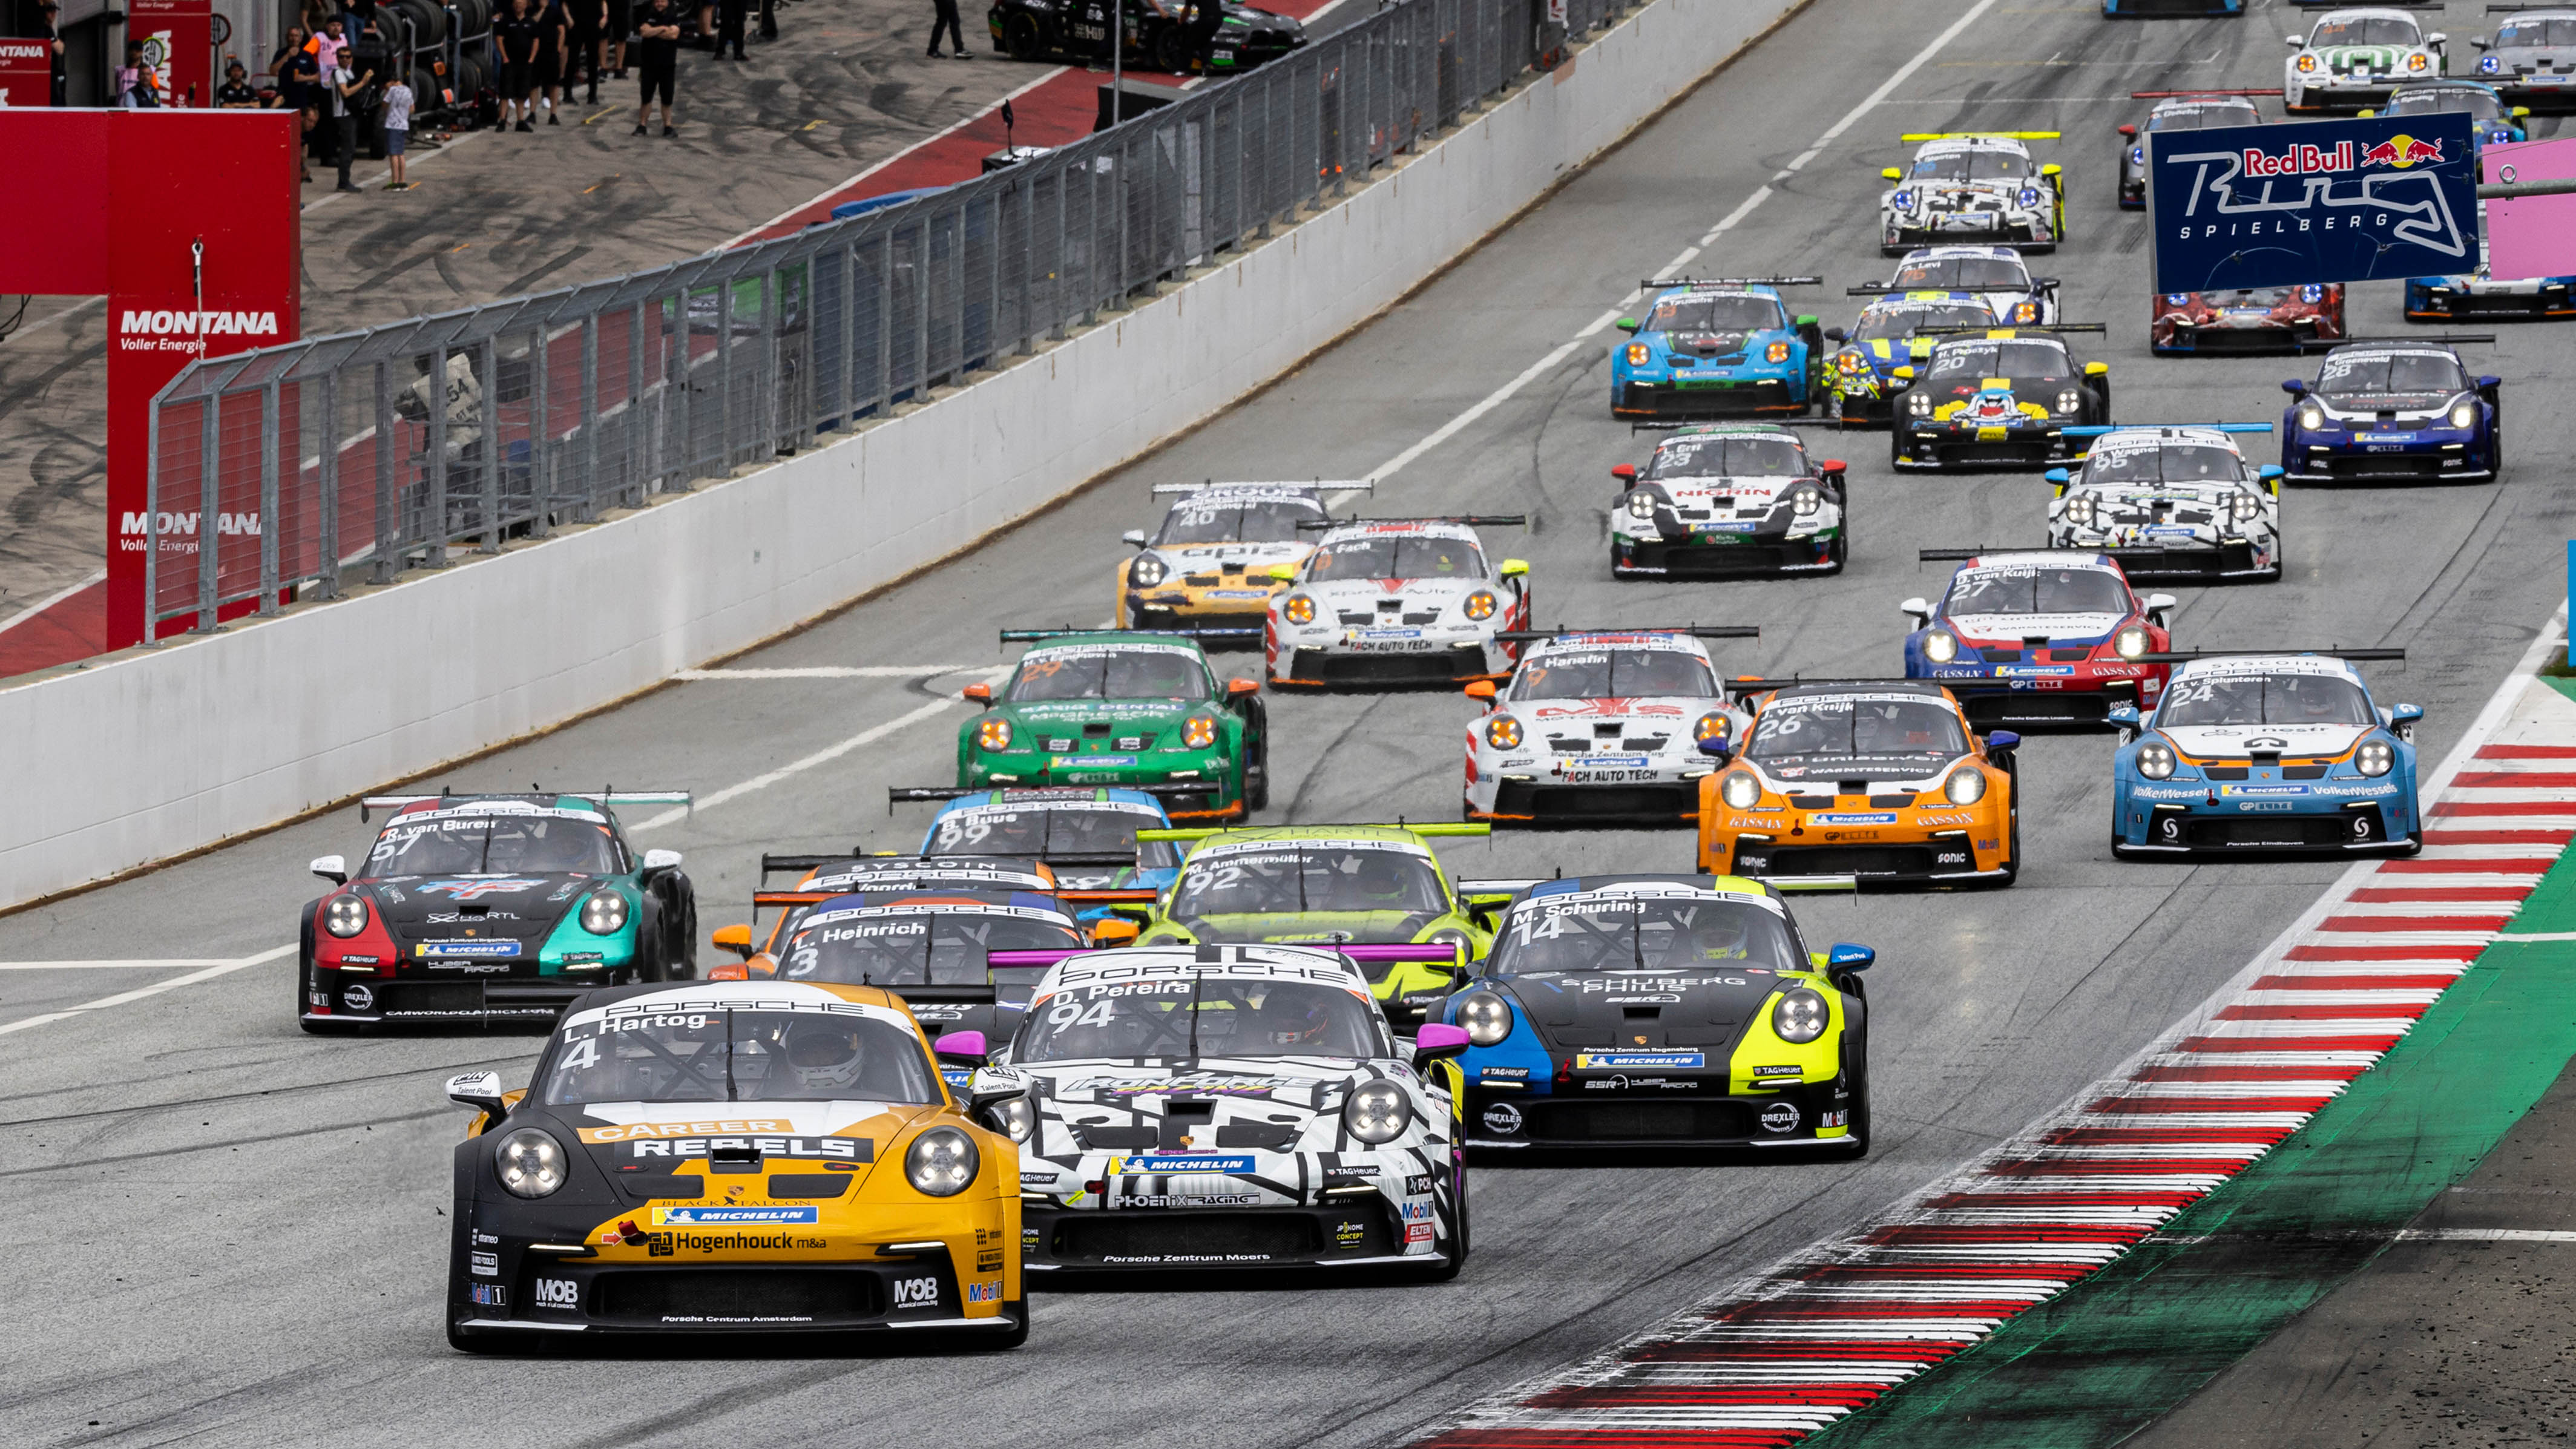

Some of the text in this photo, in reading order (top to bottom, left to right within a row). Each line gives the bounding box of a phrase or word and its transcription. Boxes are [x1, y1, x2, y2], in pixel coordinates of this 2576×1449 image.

[2244, 141, 2353, 177] Red Bull
[2180, 213, 2388, 239] SPIELBERG
[120, 310, 278, 335] MONTANA
[120, 337, 206, 353] Voller Energie
[1935, 356, 1966, 373] 20
[2334, 355, 2391, 366] Groeneveld
[2322, 364, 2352, 382] 28
[2099, 438, 2229, 450] PORSCHE
[1657, 452, 1692, 470] 23
[2094, 456, 2128, 473] 95
[1676, 488, 1771, 498] NIGRIN
[1180, 511, 1216, 528] 40
[1972, 562, 2103, 573] PORSCHE
[1955, 567, 2040, 585] D. van Kuijk
[1950, 580, 1992, 602] 27
[1350, 642, 1376, 651] FACH
[1545, 653, 1608, 666] Hanafin
[1022, 660, 1063, 683] 29
[1527, 668, 1548, 687] 9
[2092, 666, 2142, 677] GASSAN
[2189, 668, 2338, 679] PORSCHE
[2009, 679, 2063, 689] GP ELITE
[2172, 683, 2188, 692] M.
[2202, 675, 2272, 686] Splunteren
[1780, 694, 1933, 707] PORSCHE
[2170, 685, 2214, 709] 24
[1761, 701, 1855, 722] J. van Kuijk
[1756, 715, 1802, 741] 26
[1562, 769, 1658, 783] FACH AUTO TECH
[2133, 784, 2215, 800] VolkerWessels
[2313, 782, 2398, 797] VolkerWessels
[406, 807, 583, 821] PORSCHE
[961, 802, 1138, 817] PORSCHE
[2239, 801, 2255, 812] GP
[941, 812, 1017, 833] B. Buus
[1729, 817, 1785, 829] GASSAN
[1916, 812, 1974, 827] GASSAN
[386, 819, 496, 841] R. van Buren
[938, 823, 992, 852] 99
[1824, 832, 1840, 841] GP
[370, 832, 422, 862] 57
[1212, 841, 1404, 855] PORSCHE
[850, 861, 996, 873] SYSCOIN
[821, 870, 1024, 886] PORSCHE
[1186, 867, 1241, 896] 92
[1537, 889, 1755, 906] PORSCHE
[485, 912, 521, 920] RTL
[827, 904, 1045, 921] PORSCHE
[1512, 899, 1647, 927] M. Schuring
[795, 922, 926, 951] L. Heinrich
[1510, 915, 1565, 947] 14
[347, 955, 378, 964] TAGHeuer
[787, 948, 820, 977] 3
[1838, 953, 1853, 962] Talent
[1058, 965, 1349, 987] PORSCHE
[1562, 976, 1747, 987] SCHUBERG
[1052, 980, 1191, 1008] D. Pereira
[1583, 983, 1687, 994] PHILIS
[343, 992, 373, 1002] DREXLER
[605, 1000, 864, 1017] PORSCHE
[1047, 999, 1116, 1036] 94
[564, 1013, 707, 1045] L. Hartog
[559, 1037, 601, 1070] 4
[1611, 1057, 1695, 1065] MICHELIN
[456, 1071, 489, 1083] PIN
[985, 1066, 1017, 1077] PIN
[1490, 1068, 1529, 1077] TAGHeuer
[1761, 1065, 1802, 1075] TAGHeuer
[476, 1087, 493, 1096] Pool
[980, 1083, 1002, 1092] Talent
[1585, 1080, 1618, 1089] SSR
[1483, 1112, 1522, 1123] DREXLER
[1761, 1112, 1801, 1124] DREXLER
[593, 1120, 780, 1142] CAREER
[1762, 1122, 1791, 1133] AUTOMOTIVE
[633, 1137, 856, 1158] REBELS
[1149, 1160, 1245, 1171] MICHELIN
[1336, 1168, 1379, 1176] TAGHeuer
[1418, 1178, 1433, 1192] PCH
[700, 1211, 804, 1221] MICHELIN
[1402, 1202, 1427, 1220] Mobil
[1336, 1232, 1364, 1240] CONCEPT
[1410, 1223, 1431, 1237] ELTEN
[676, 1231, 827, 1253] Hogenhouck m&a
[535, 1278, 579, 1304] MOB
[893, 1276, 939, 1304] MOB
[968, 1280, 996, 1303] Mobil
